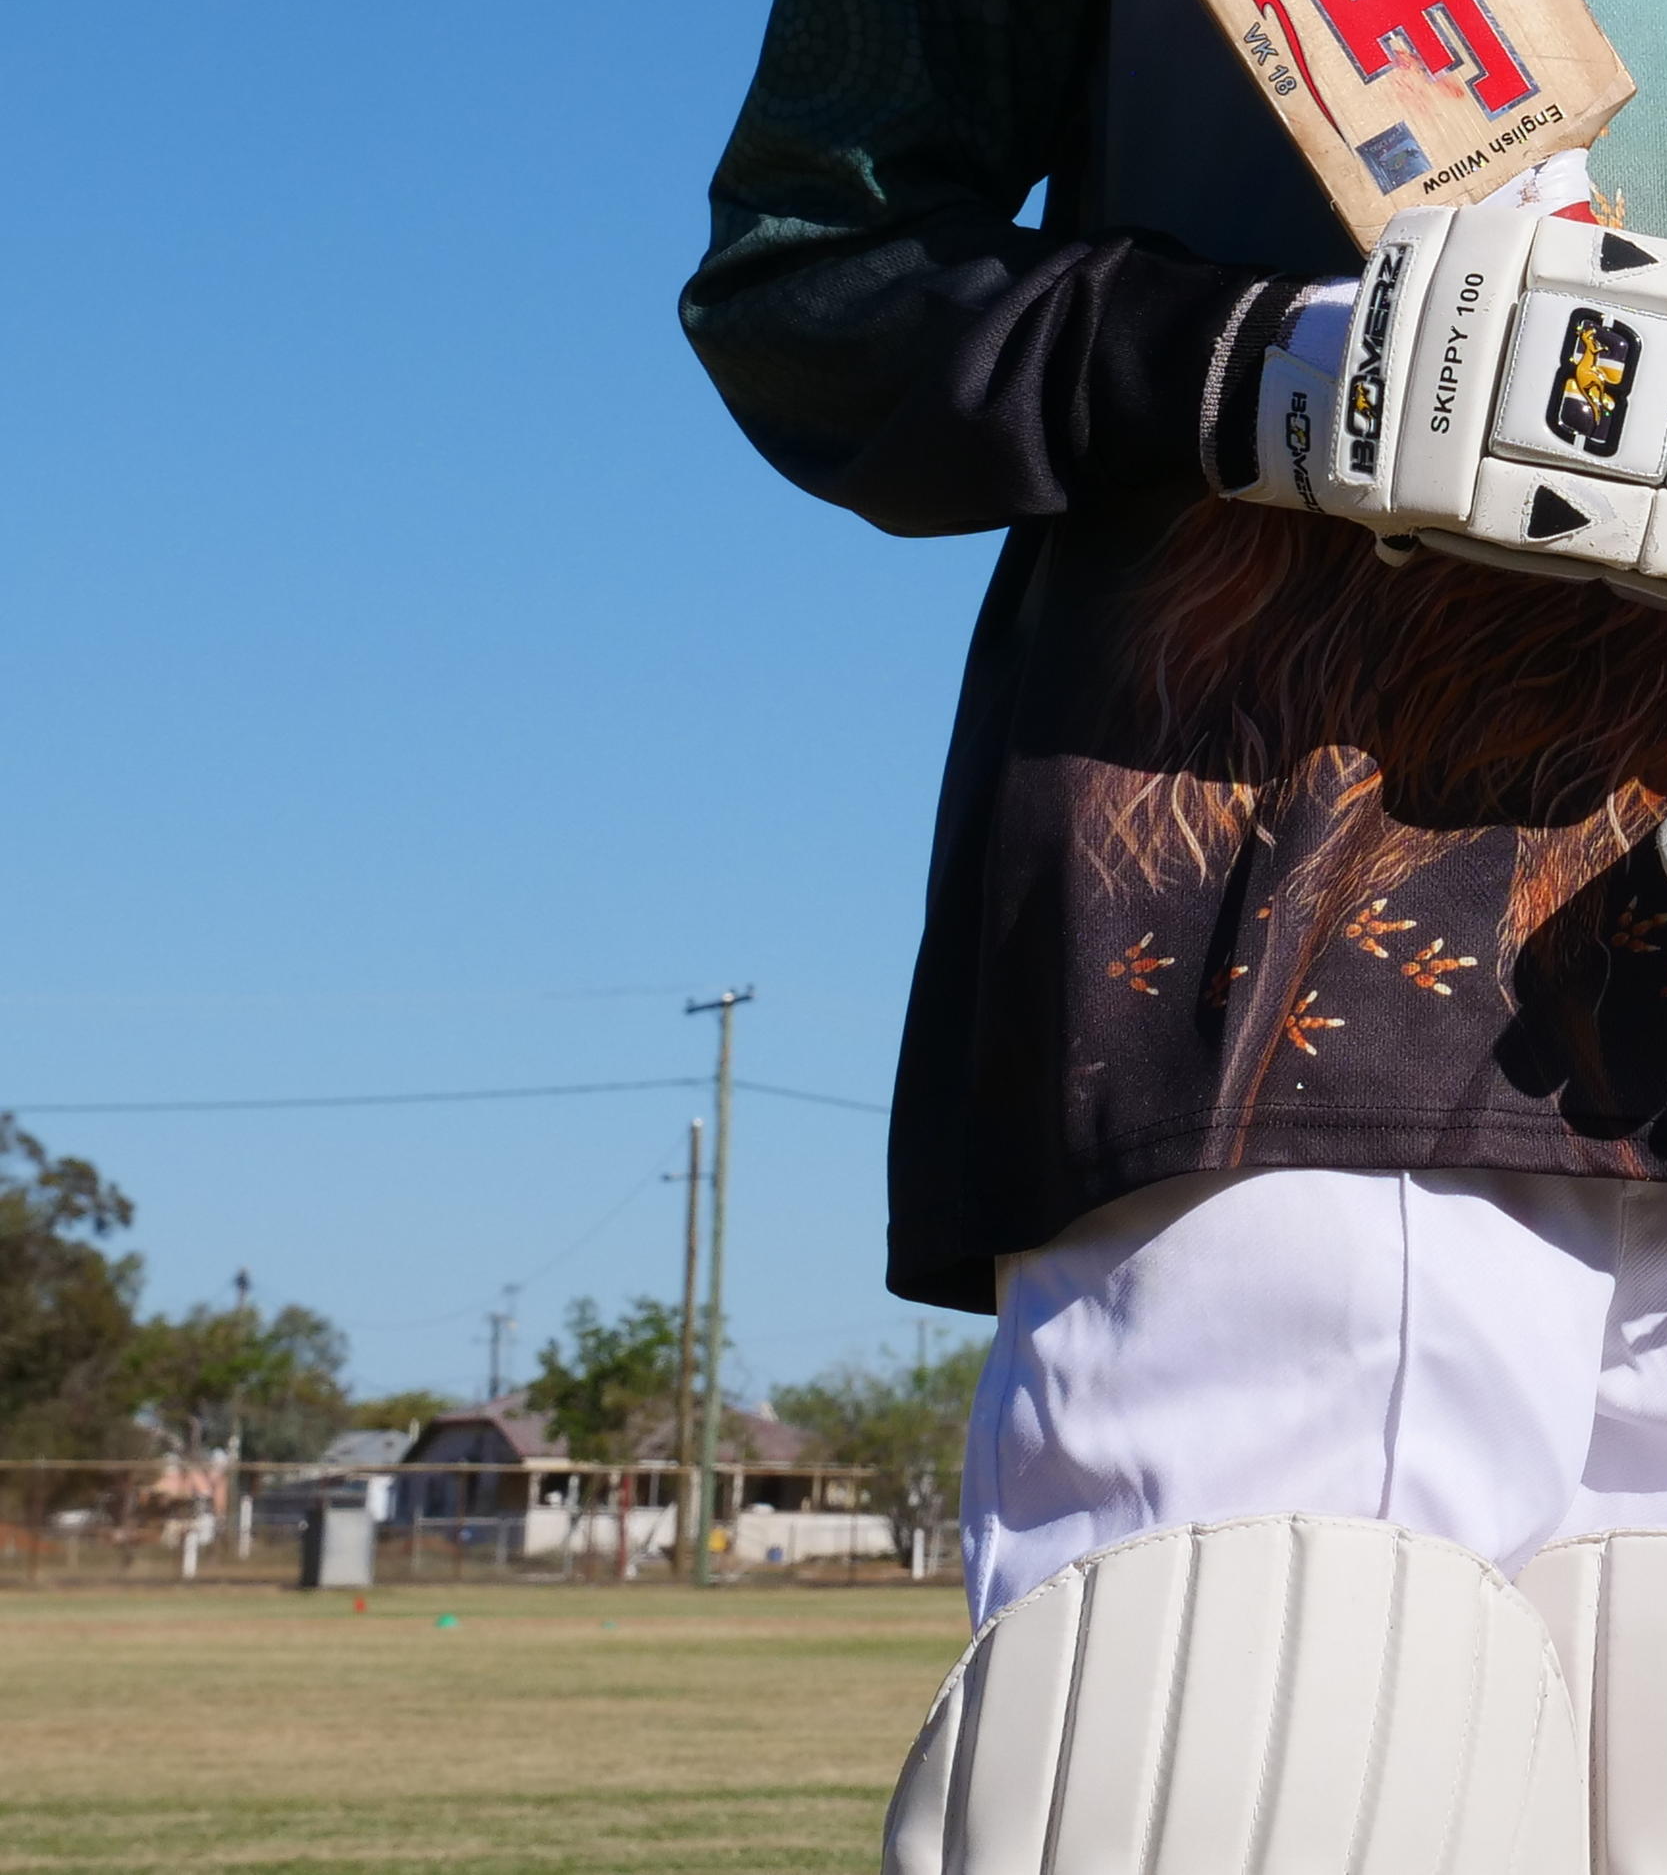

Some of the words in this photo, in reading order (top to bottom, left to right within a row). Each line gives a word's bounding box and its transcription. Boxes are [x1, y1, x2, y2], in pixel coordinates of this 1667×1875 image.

[1243, 22, 1279, 66] VK
[1268, 64, 1298, 97] 18
[1489, 103, 1564, 155] English
[1423, 149, 1491, 194] Willow
[1431, 325, 1469, 435] SKIPPY
[1456, 273, 1485, 318] 100
